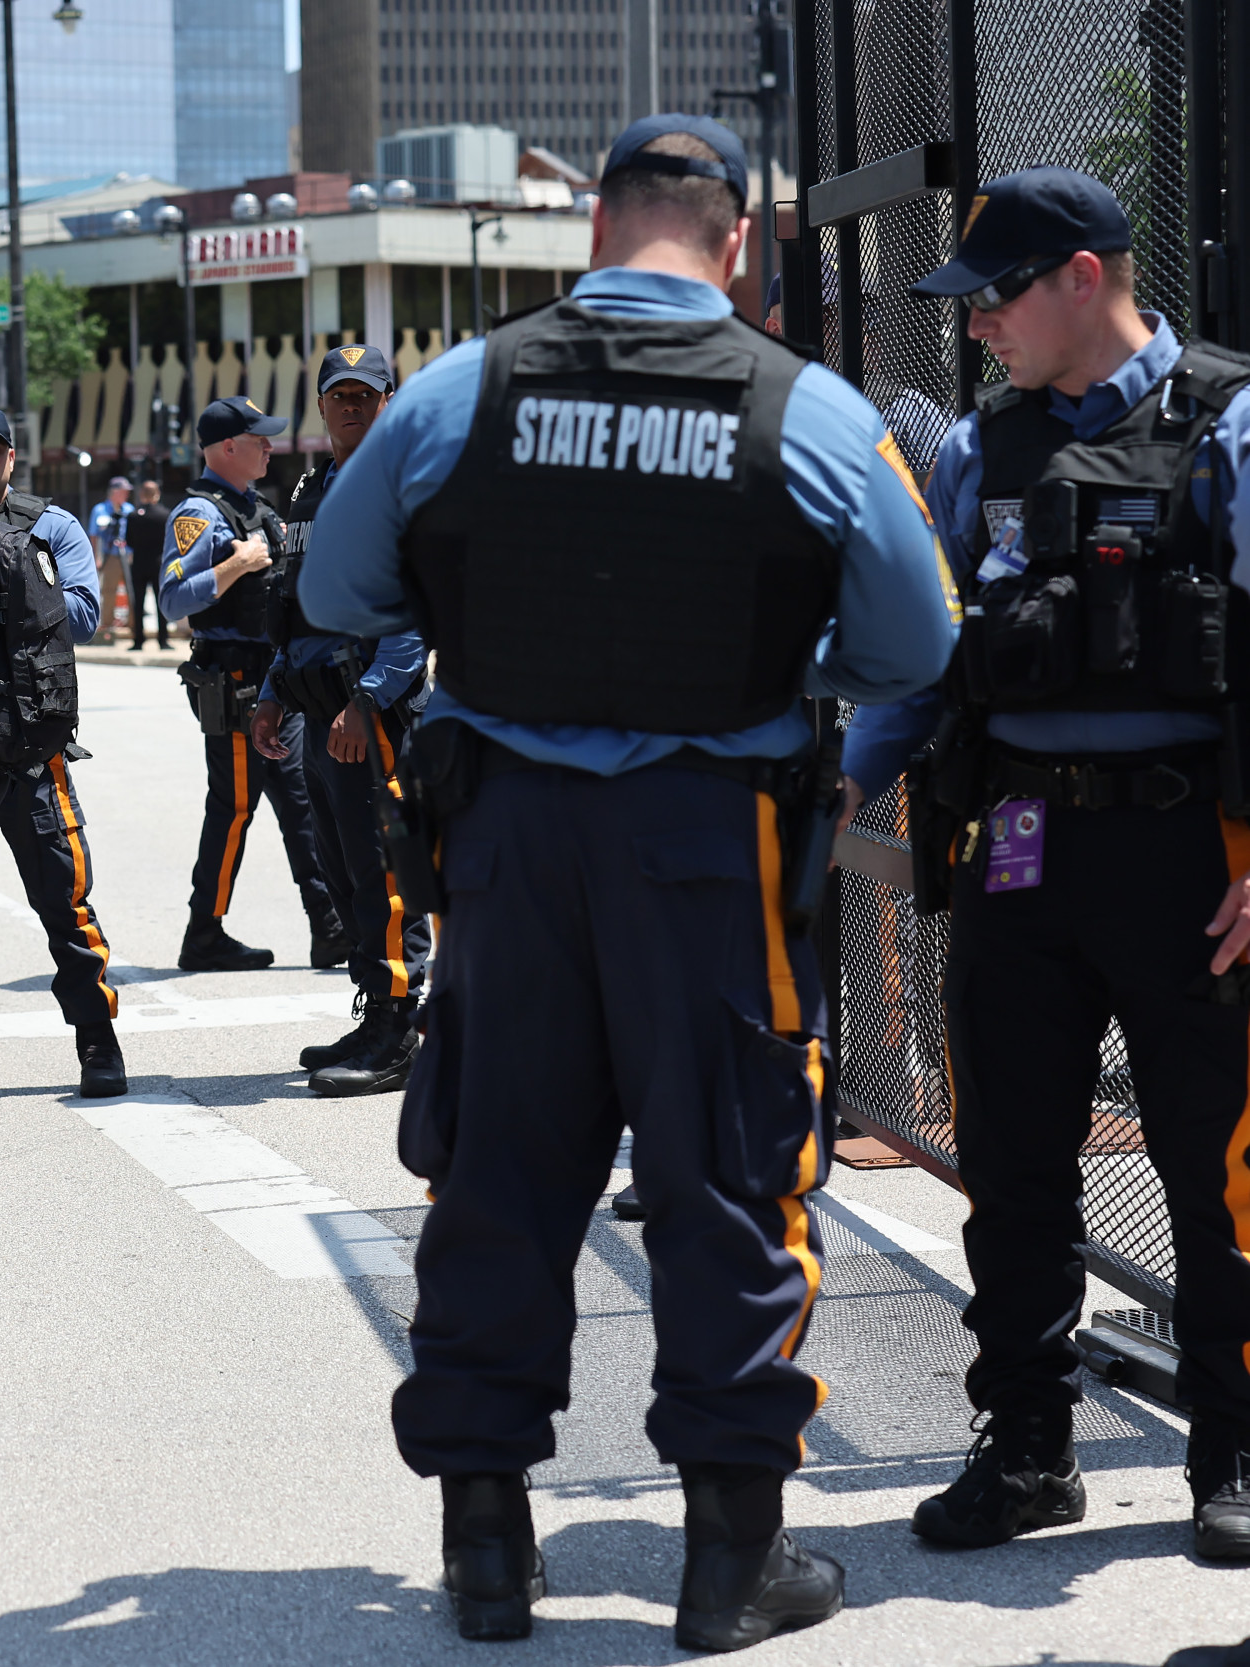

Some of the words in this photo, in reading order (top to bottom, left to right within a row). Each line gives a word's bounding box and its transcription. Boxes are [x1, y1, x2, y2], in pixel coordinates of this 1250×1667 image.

[512, 396, 614, 469] STATE
[614, 405, 740, 480] POLICE
[1097, 547, 1125, 565] TO
